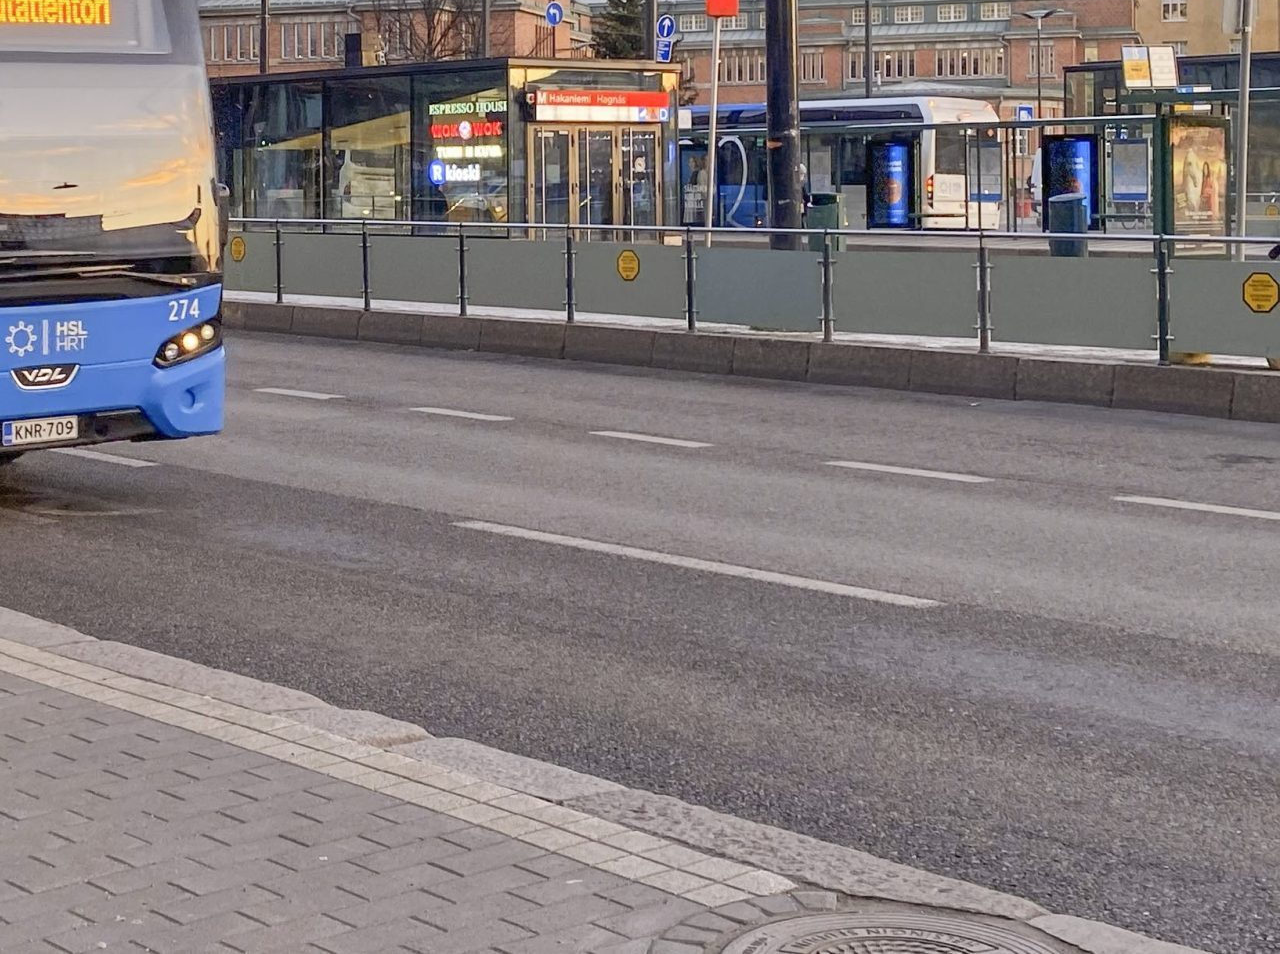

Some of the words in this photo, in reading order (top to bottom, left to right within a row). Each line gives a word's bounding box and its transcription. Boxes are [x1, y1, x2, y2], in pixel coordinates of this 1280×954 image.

[537, 93, 548, 104] M
[549, 94, 592, 103] Hakaniemi
[429, 102, 475, 116] ESPRESSO
[431, 124, 460, 139] WOK
[471, 122, 503, 137] WOK
[445, 163, 480, 181] kioski
[168, 298, 200, 321] 274
[56, 320, 88, 336] HSL
[56, 335, 88, 352] HRT
[21, 368, 67, 382] VDL
[14, 420, 74, 441] KNR-709
